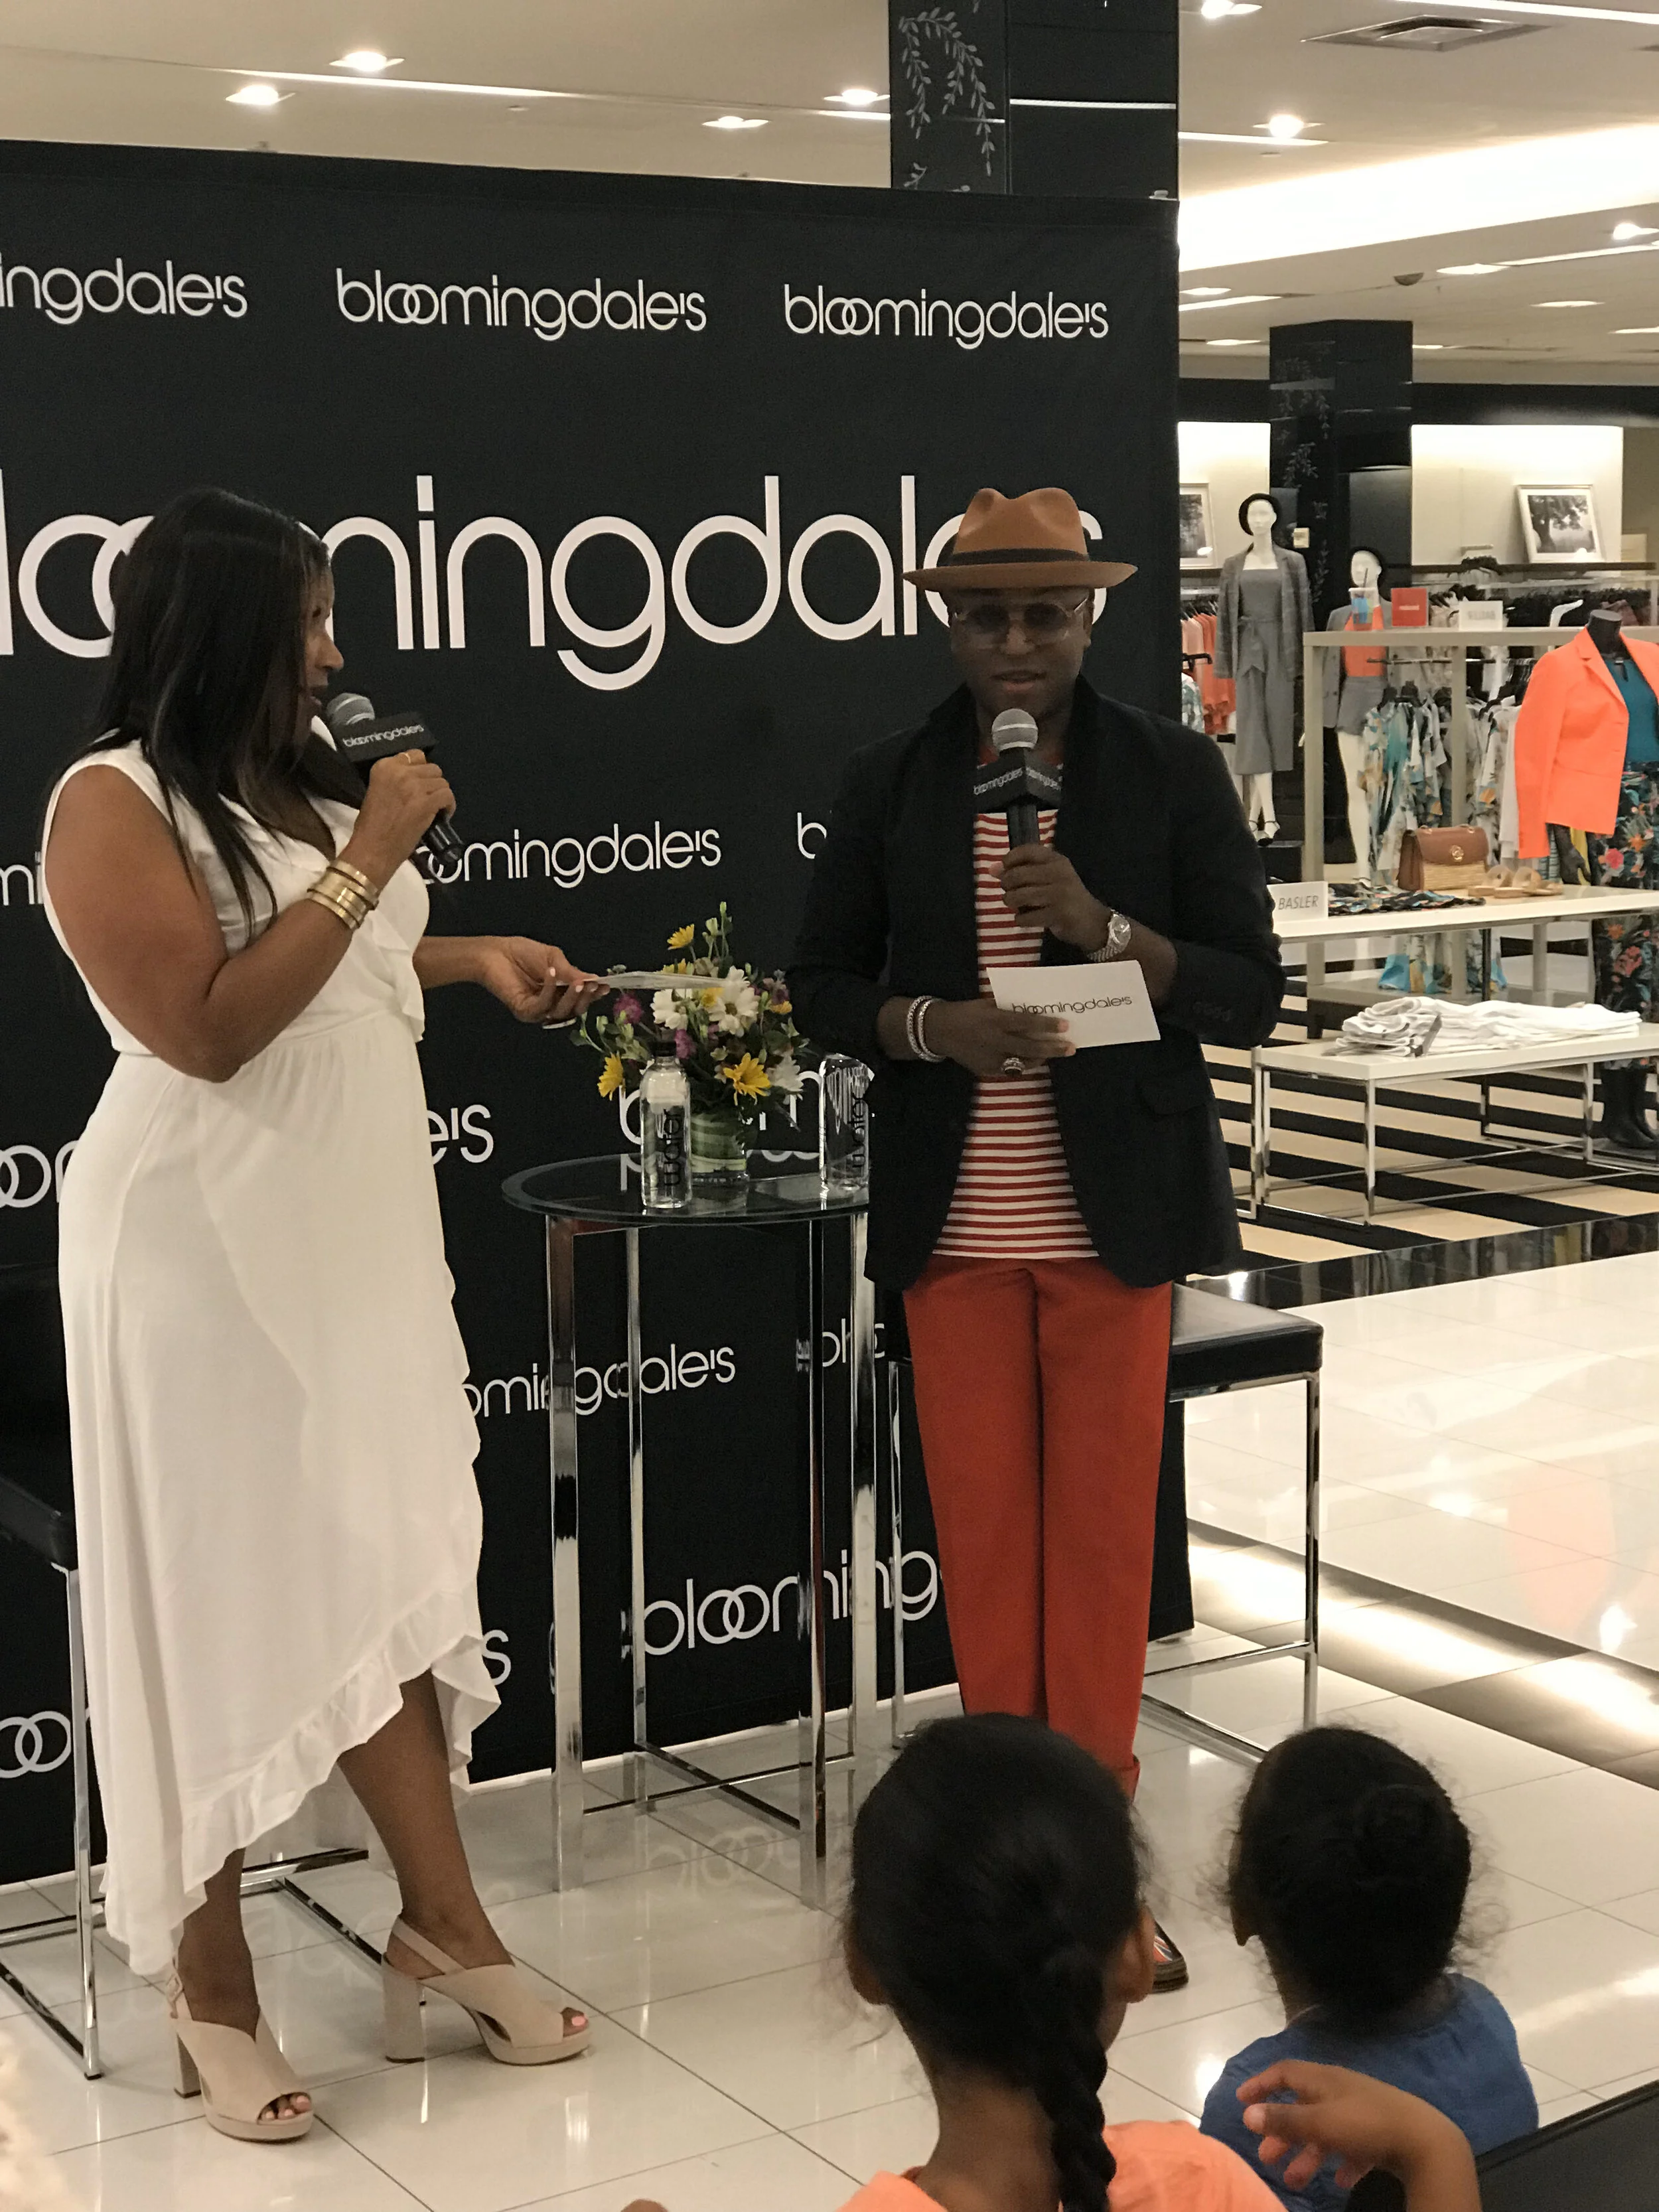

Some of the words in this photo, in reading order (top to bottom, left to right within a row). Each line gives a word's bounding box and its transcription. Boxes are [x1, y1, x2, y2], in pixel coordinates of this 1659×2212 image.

[336, 267, 707, 341] bloomingdale's
[784, 284, 1109, 350] bloomingdale's
[1278, 895, 1319, 911] BASLER
